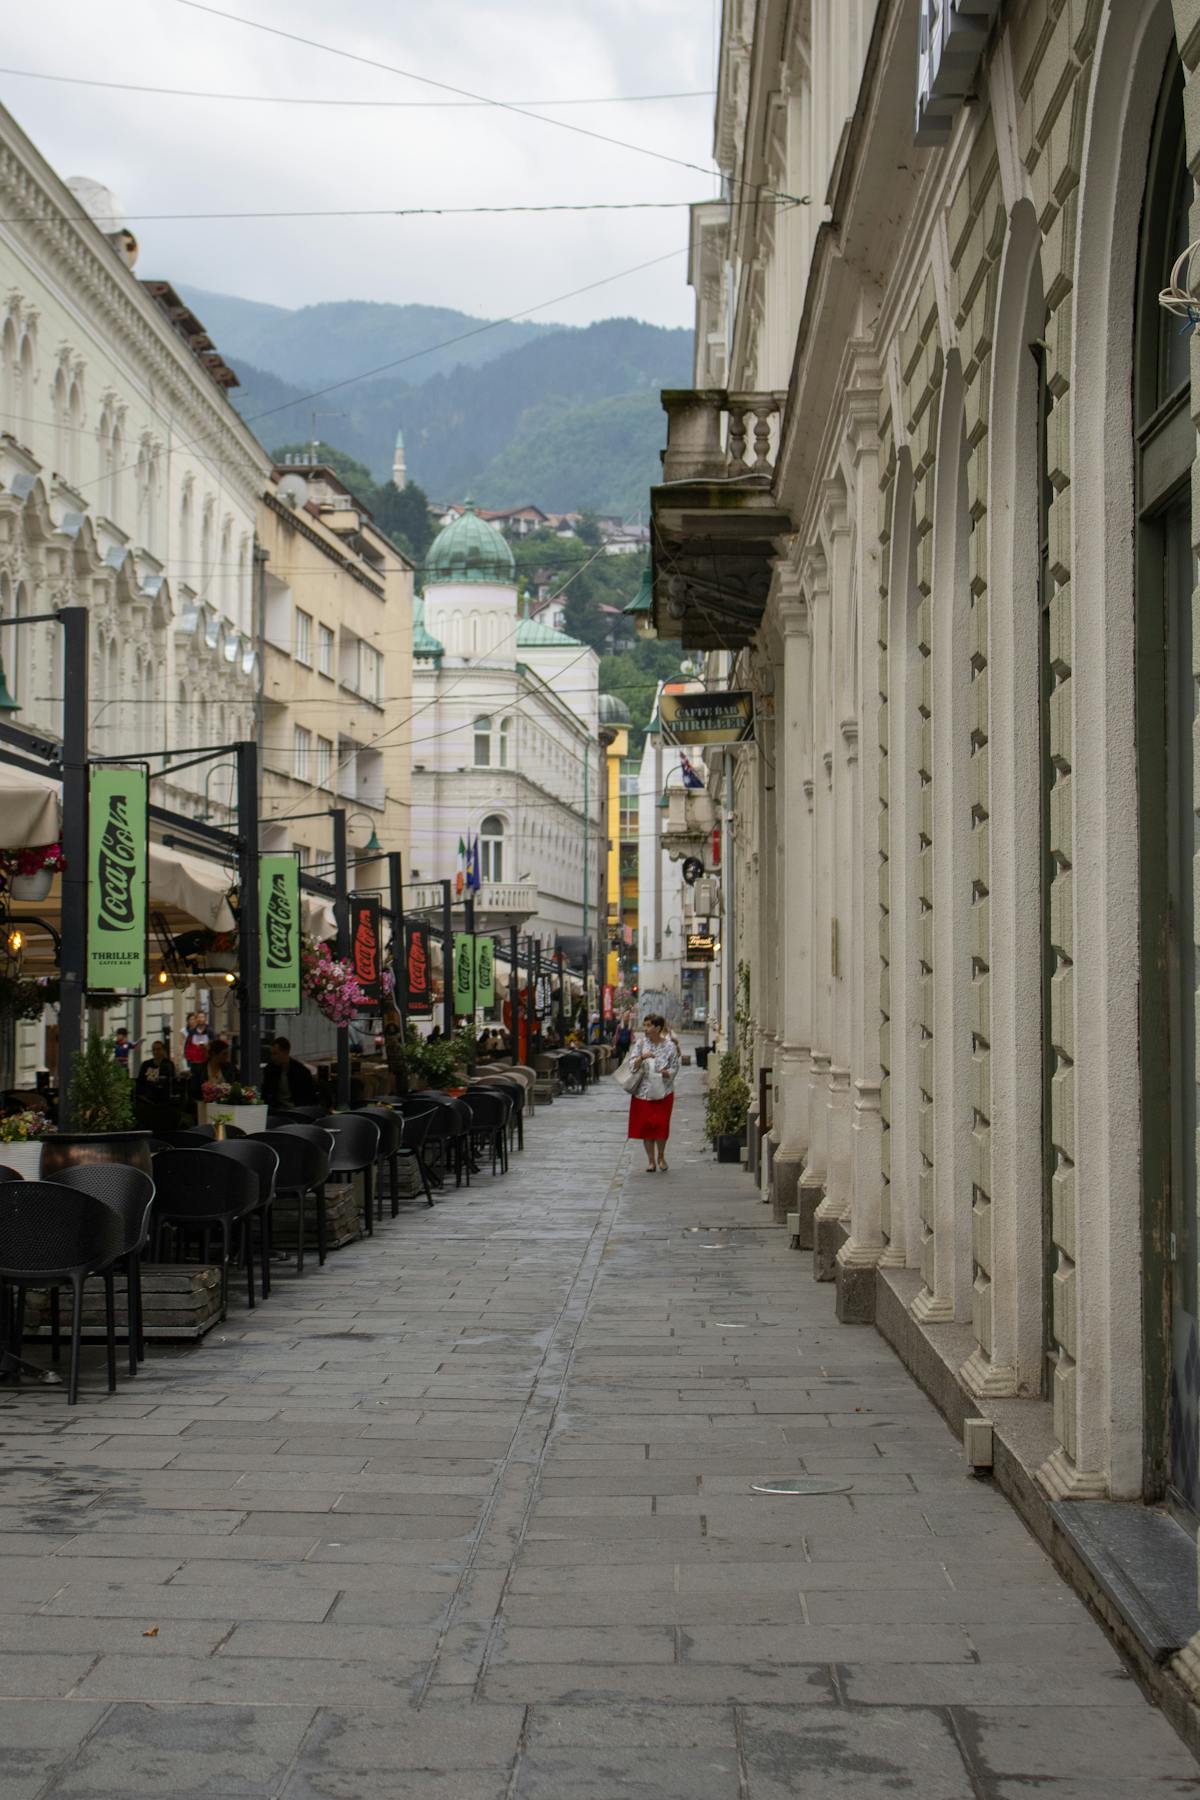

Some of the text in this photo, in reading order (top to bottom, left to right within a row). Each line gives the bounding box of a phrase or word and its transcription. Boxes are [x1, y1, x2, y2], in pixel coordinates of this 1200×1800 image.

[715, 704, 738, 717] BAR
[670, 717, 747, 733] THRILLER
[91, 951, 141, 961] THRILLER
